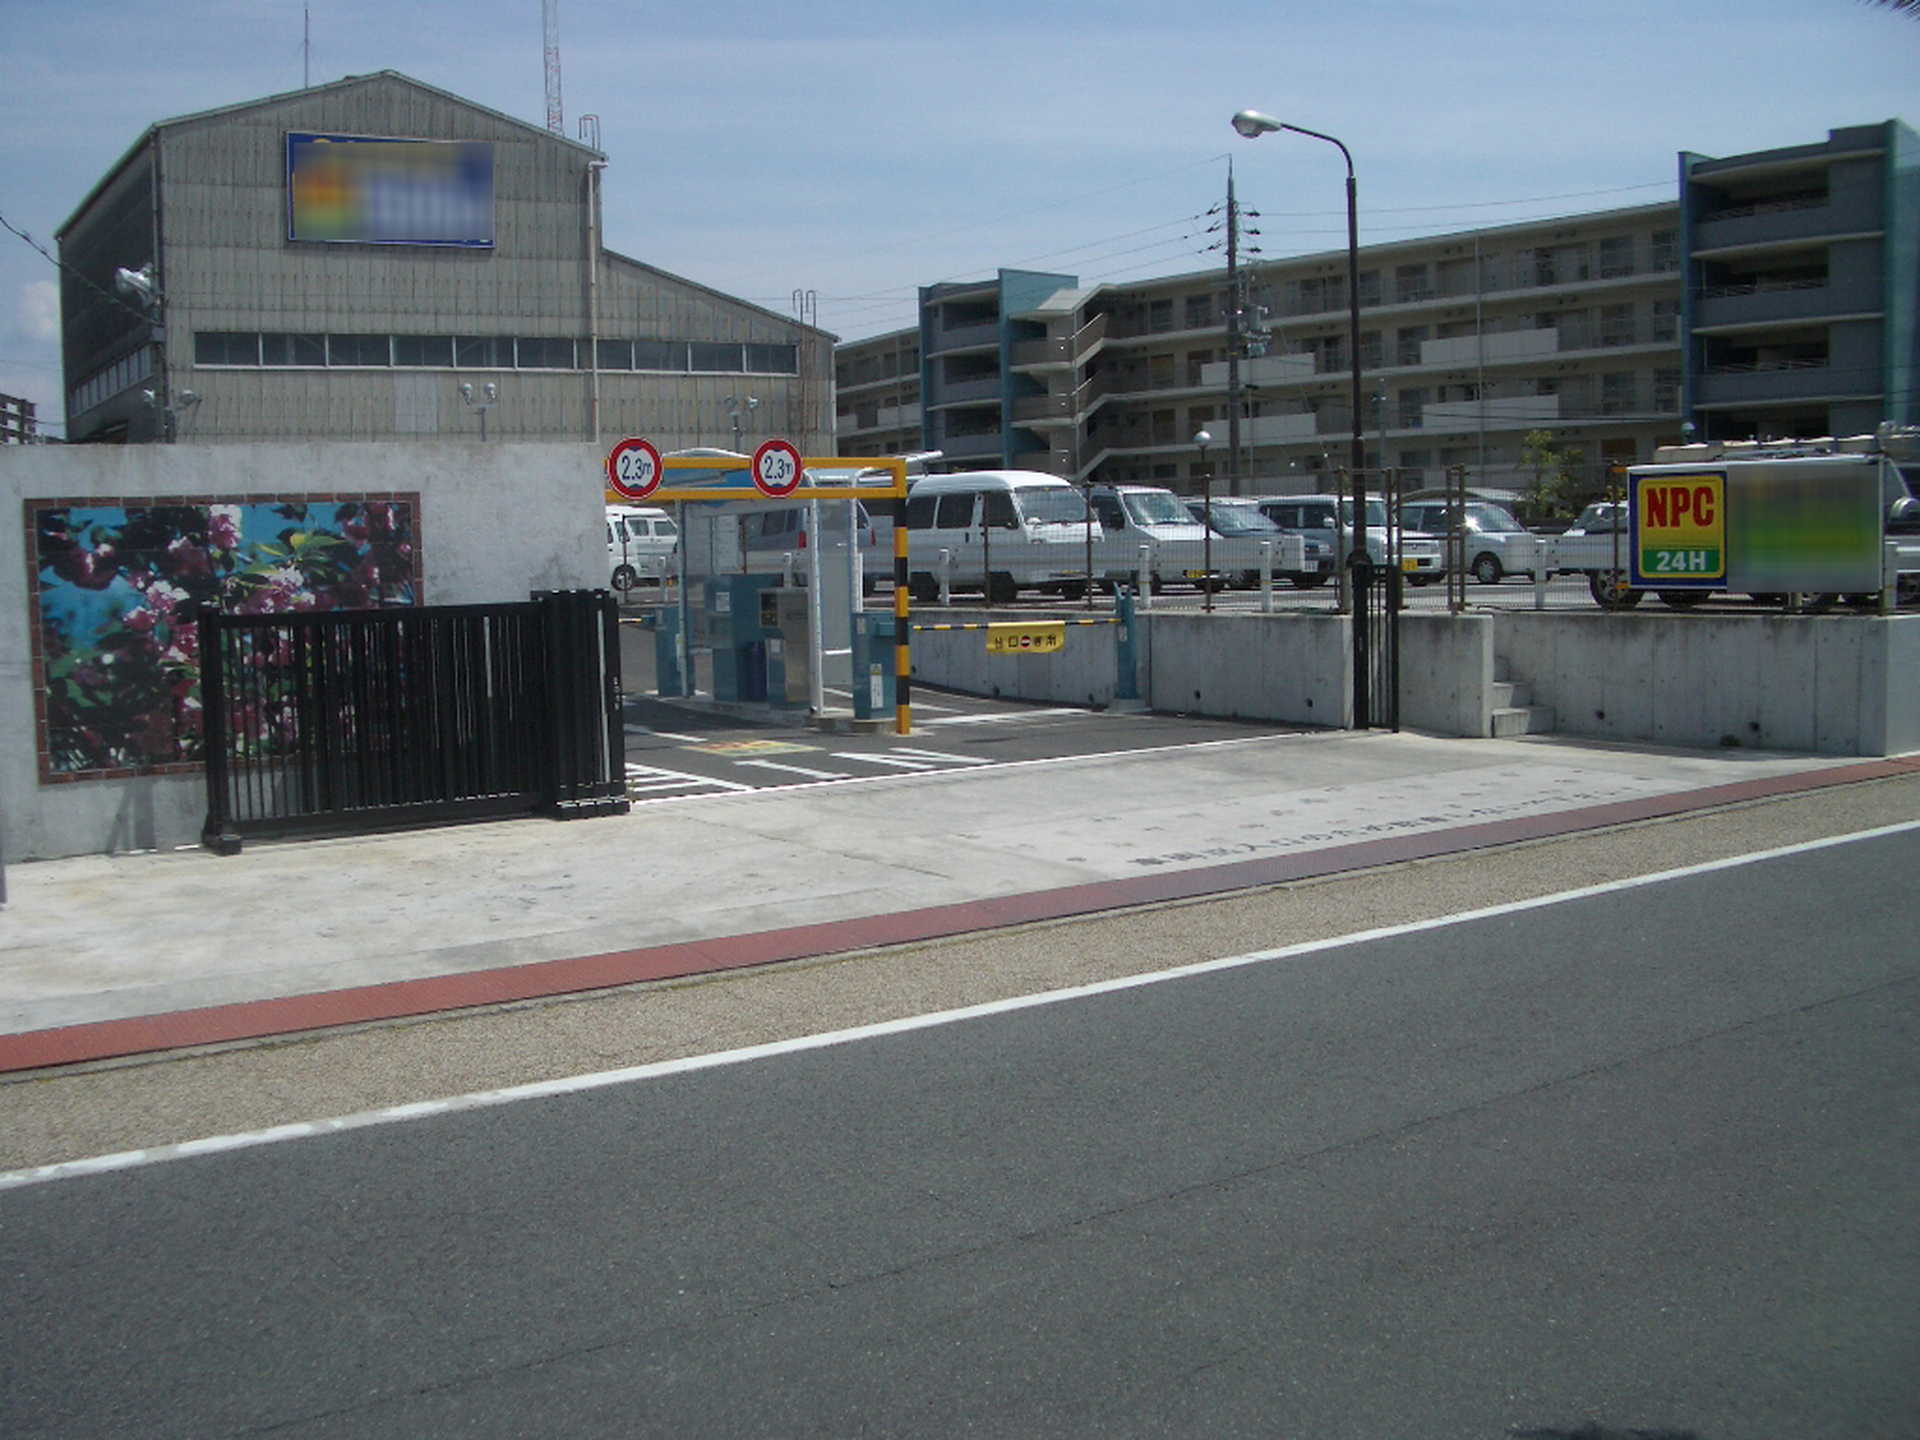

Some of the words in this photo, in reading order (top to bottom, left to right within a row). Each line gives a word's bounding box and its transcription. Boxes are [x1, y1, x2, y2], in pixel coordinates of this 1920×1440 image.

[622, 455, 652, 479] 2.3m
[764, 455, 793, 479] 2.3m
[1646, 487, 1714, 528] NPC
[1656, 551, 1706, 571] 24H
